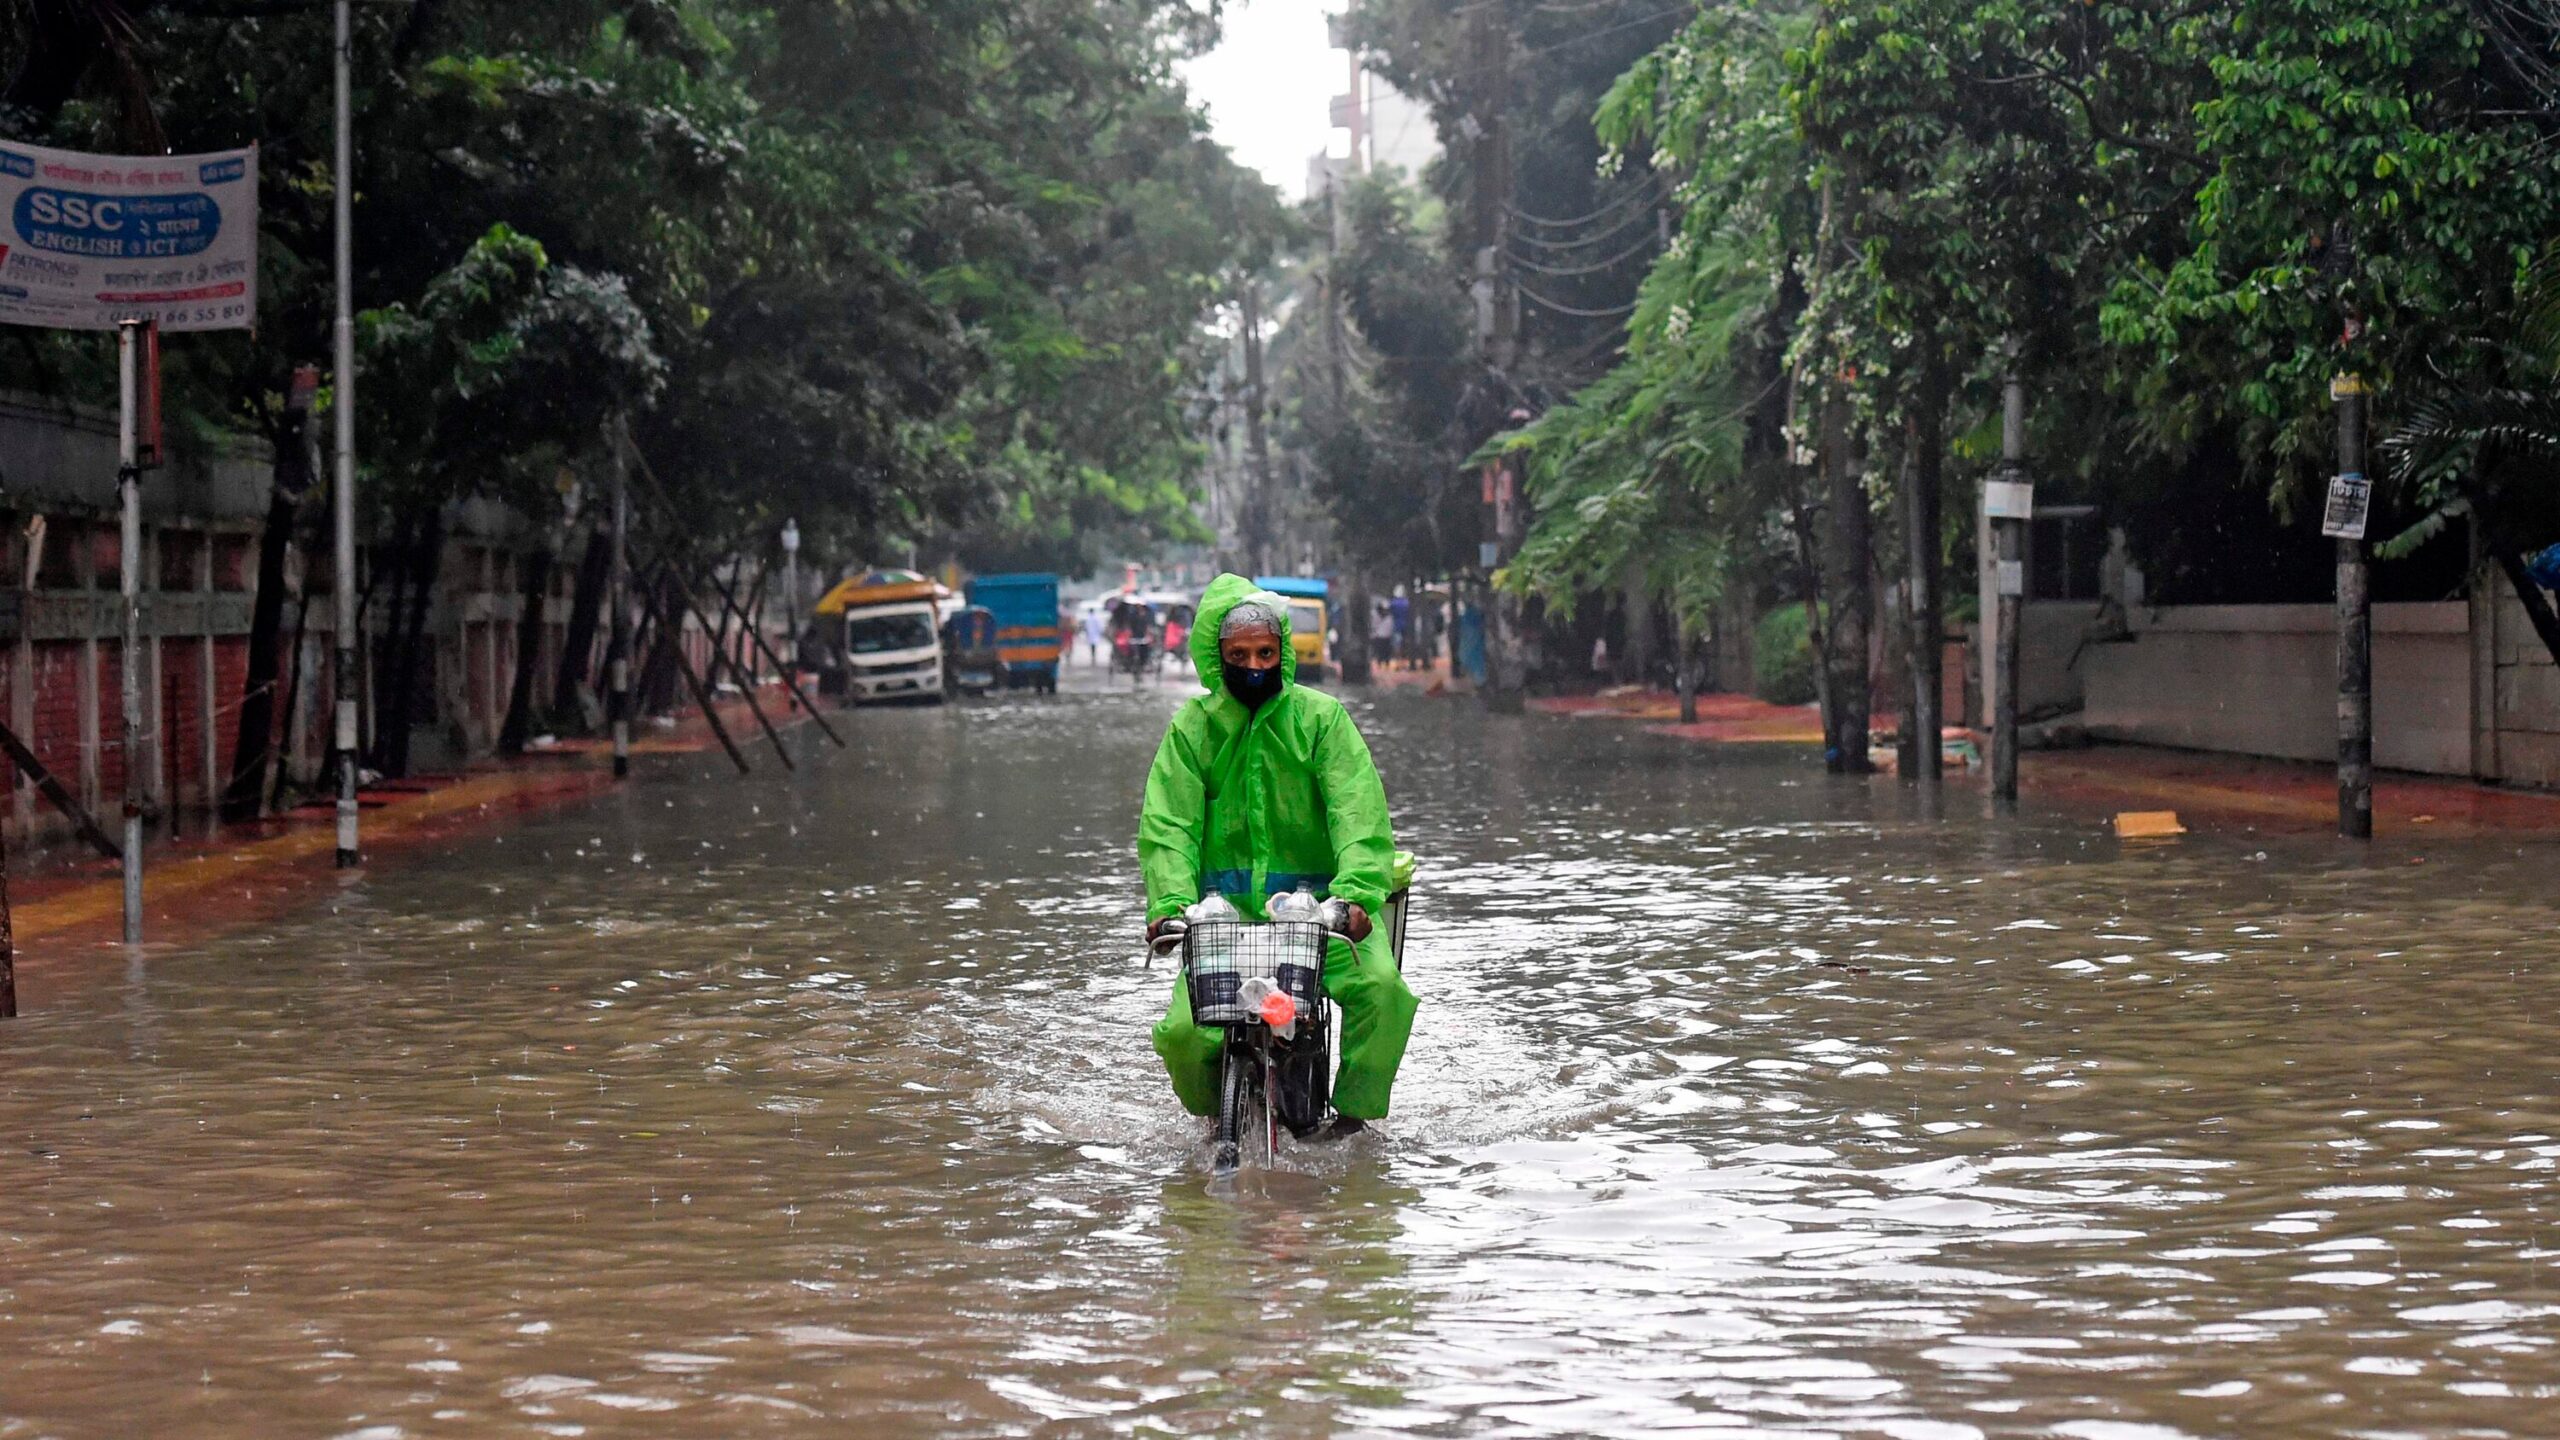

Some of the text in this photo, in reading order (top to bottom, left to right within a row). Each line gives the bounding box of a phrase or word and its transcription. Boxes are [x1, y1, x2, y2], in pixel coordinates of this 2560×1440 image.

[30, 192, 123, 231] SSC
[32, 230, 122, 254] ENGLISH
[145, 238, 177, 254] ICT
